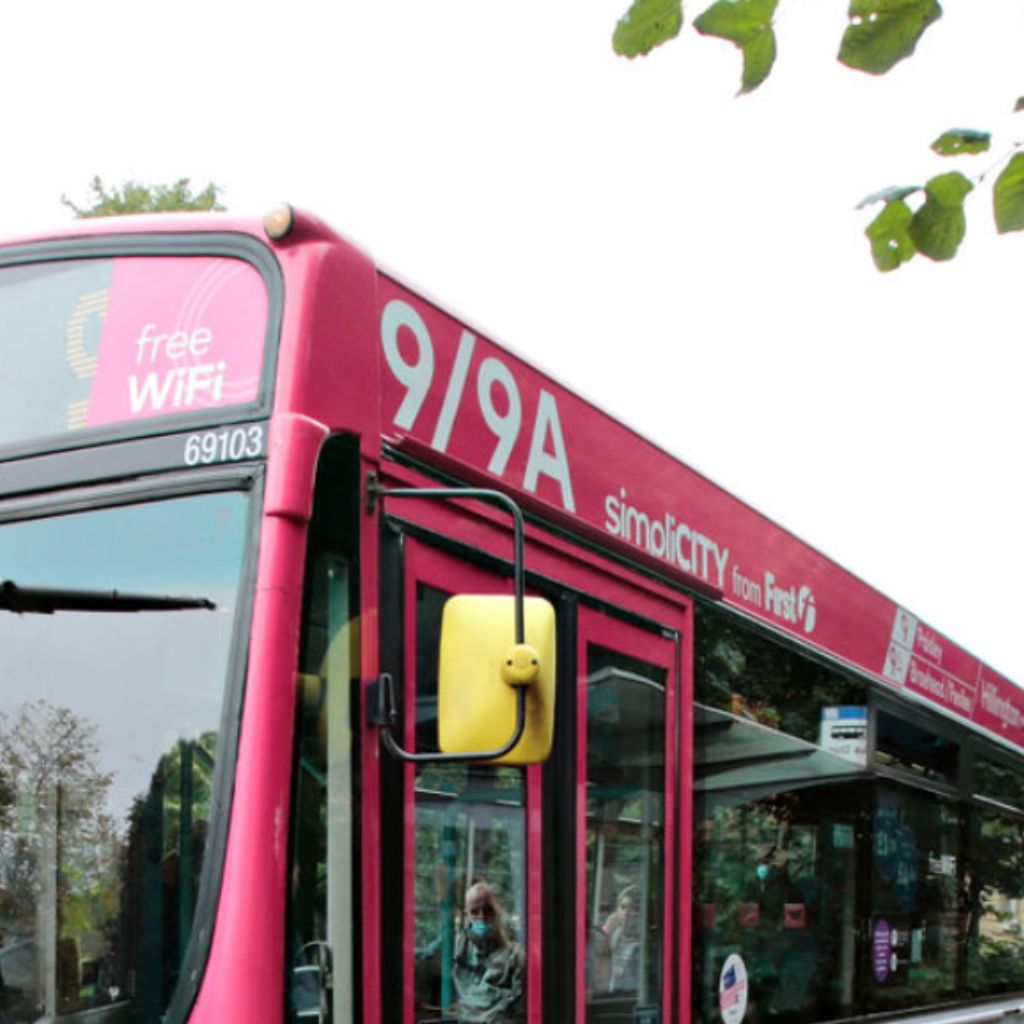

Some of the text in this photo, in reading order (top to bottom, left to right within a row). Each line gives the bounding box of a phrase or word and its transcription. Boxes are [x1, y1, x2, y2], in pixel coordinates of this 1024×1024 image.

[135, 323, 213, 365] free
[128, 361, 226, 413] WiFi
[380, 299, 576, 514] 9/9A
[184, 426, 263, 465] 69103
[732, 564, 761, 607] from
[764, 571, 798, 624] First
